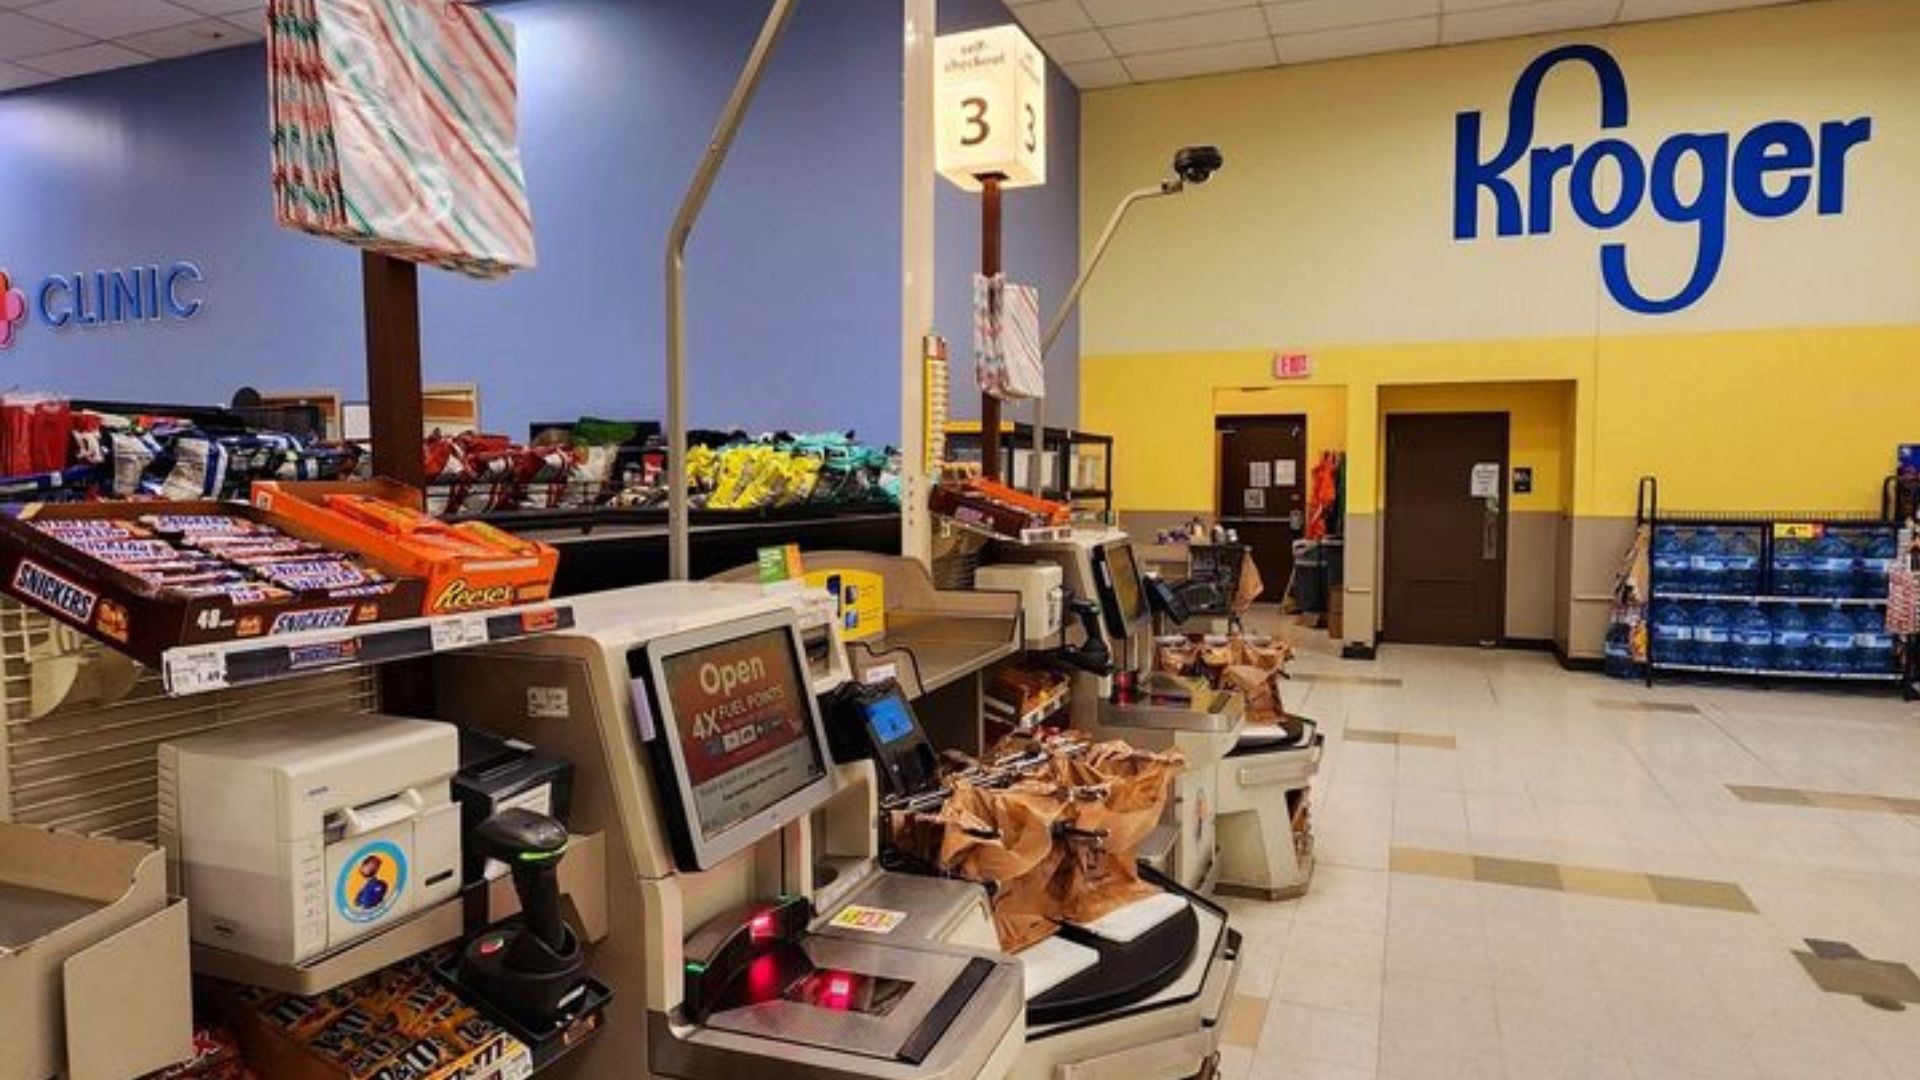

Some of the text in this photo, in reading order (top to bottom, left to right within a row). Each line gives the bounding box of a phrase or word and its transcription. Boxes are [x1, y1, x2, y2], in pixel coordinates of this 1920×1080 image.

[944, 53, 1006, 72] checkout
[959, 96, 990, 146] 3
[1024, 102, 1037, 154] 3
[1454, 44, 1871, 315] Kroger
[38, 260, 204, 328] CLINIC
[18, 563, 92, 619] SNICKERS
[272, 607, 347, 634] SNICKERS
[700, 656, 767, 697] Open
[692, 708, 721, 740] 4X
[719, 700, 748, 719] FUEL
